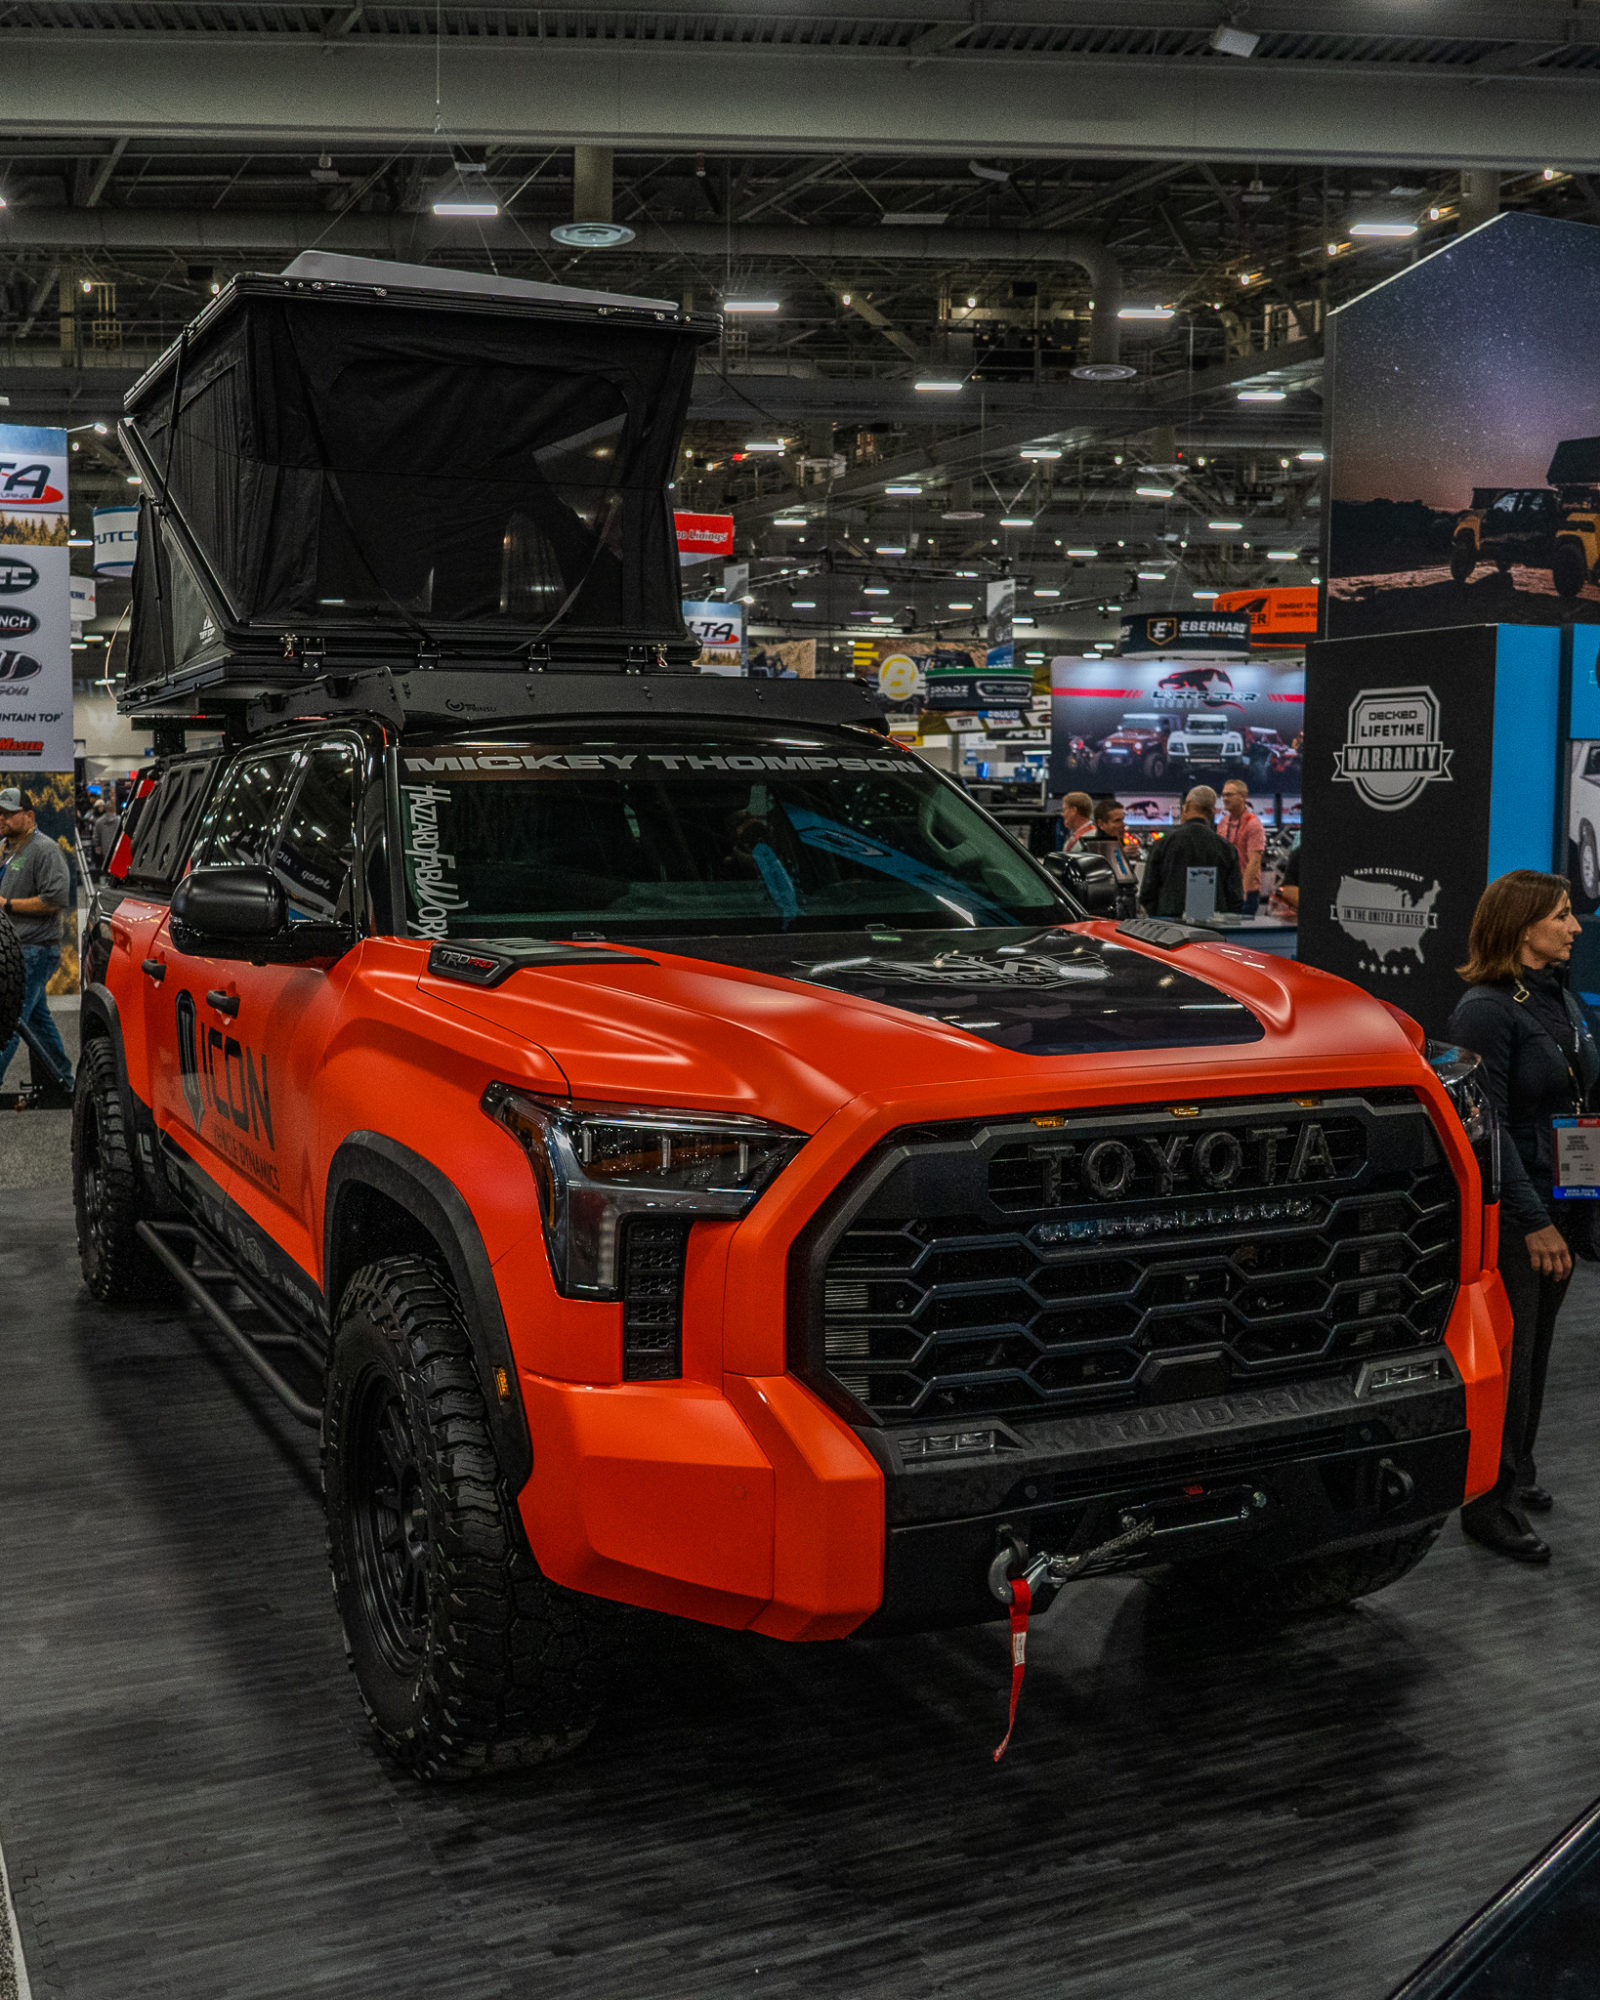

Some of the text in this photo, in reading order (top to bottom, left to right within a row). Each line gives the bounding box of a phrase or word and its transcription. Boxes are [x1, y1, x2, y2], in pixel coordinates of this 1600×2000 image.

[1179, 620, 1247, 633] EBERHARD
[0, 713, 36, 723] NTAIN
[1369, 710, 1417, 721] DECKED
[1361, 724, 1424, 738] LIFETIME
[403, 755, 923, 774] MICKEY THOMPSON
[1348, 747, 1437, 770] WARRANTY
[1354, 867, 1424, 882] MADE EXCLUSIVELY
[1354, 909, 1366, 921] THE
[1368, 911, 1394, 924] UNITED
[1397, 913, 1424, 926] STATES
[441, 950, 470, 966] TRD
[201, 1021, 275, 1152] ICON
[1028, 1121, 1337, 1206] TOYOTA
